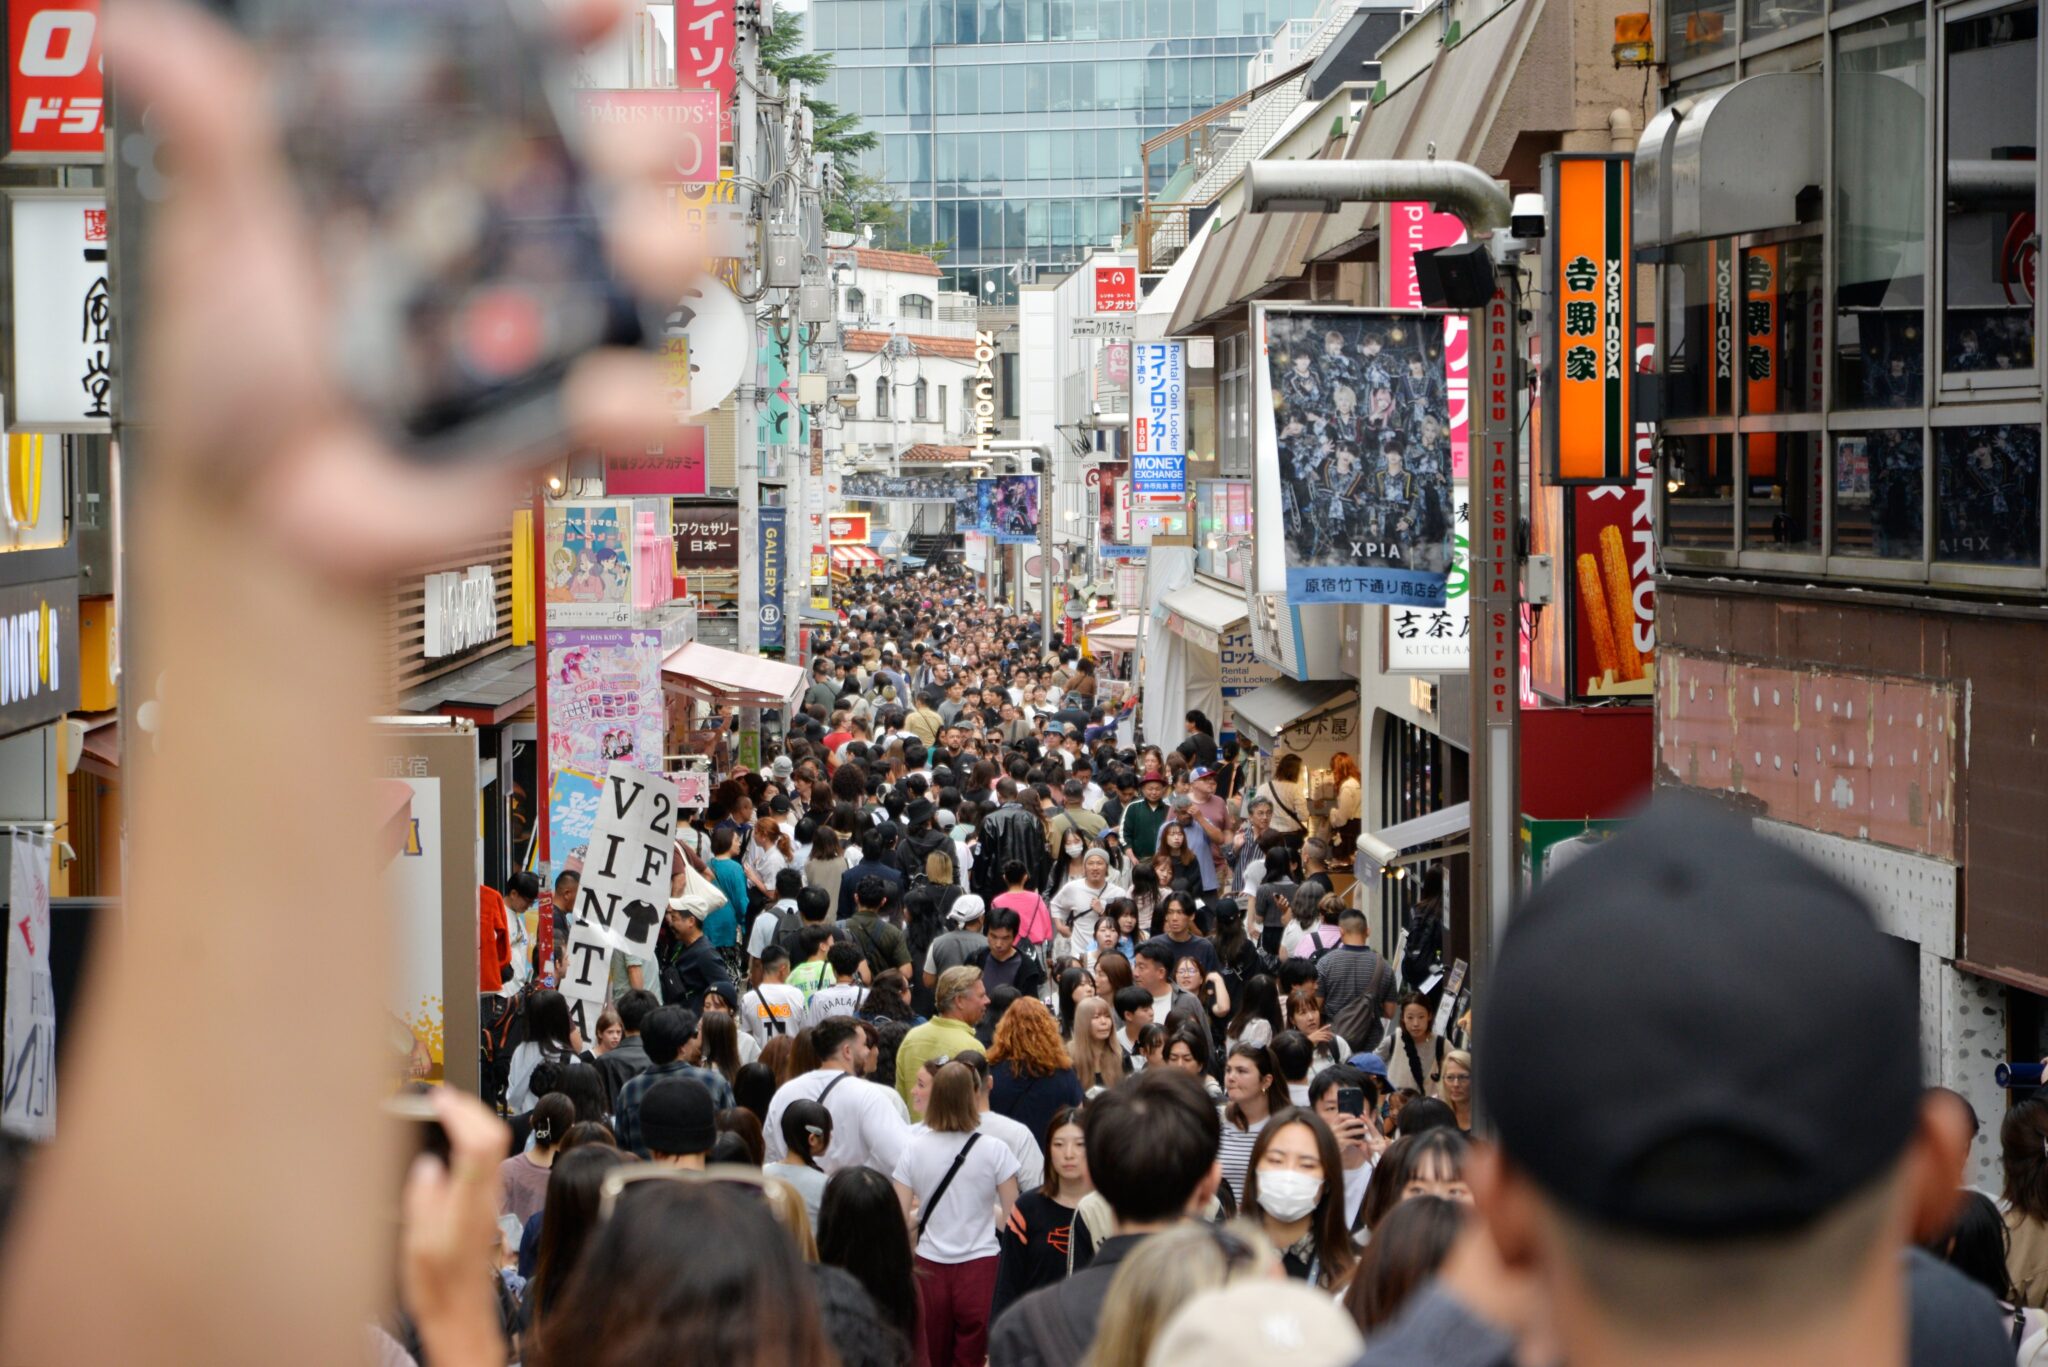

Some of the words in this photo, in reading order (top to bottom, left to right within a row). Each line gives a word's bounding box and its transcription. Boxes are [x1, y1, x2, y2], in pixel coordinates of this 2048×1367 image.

[1105, 301, 1136, 310] アガサ
[1565, 256, 1599, 382] 吉野家
[1096, 321, 1133, 335] クリスティー
[974, 330, 995, 379] NOA
[1136, 346, 1146, 384] 竹下通り
[1170, 345, 1180, 381] Rental
[1491, 288, 1506, 421] HARAJUKU
[1150, 345, 1167, 452] コインロッカー
[1170, 386, 1180, 410] Coin
[1170, 413, 1180, 452] Locker
[1134, 457, 1183, 469] MONEY
[1134, 470, 1183, 479] EXCHANGE
[1135, 494, 1147, 503] 1F
[1492, 441, 1506, 593] TAKESHITA
[691, 540, 731, 552] 日本一
[765, 527, 777, 597] GALLERY
[1304, 578, 1438, 598] 原宿竹下通り商店会
[1493, 612, 1506, 714] Street
[385, 755, 429, 777] 原宿
[635, 792, 671, 886] 2F
